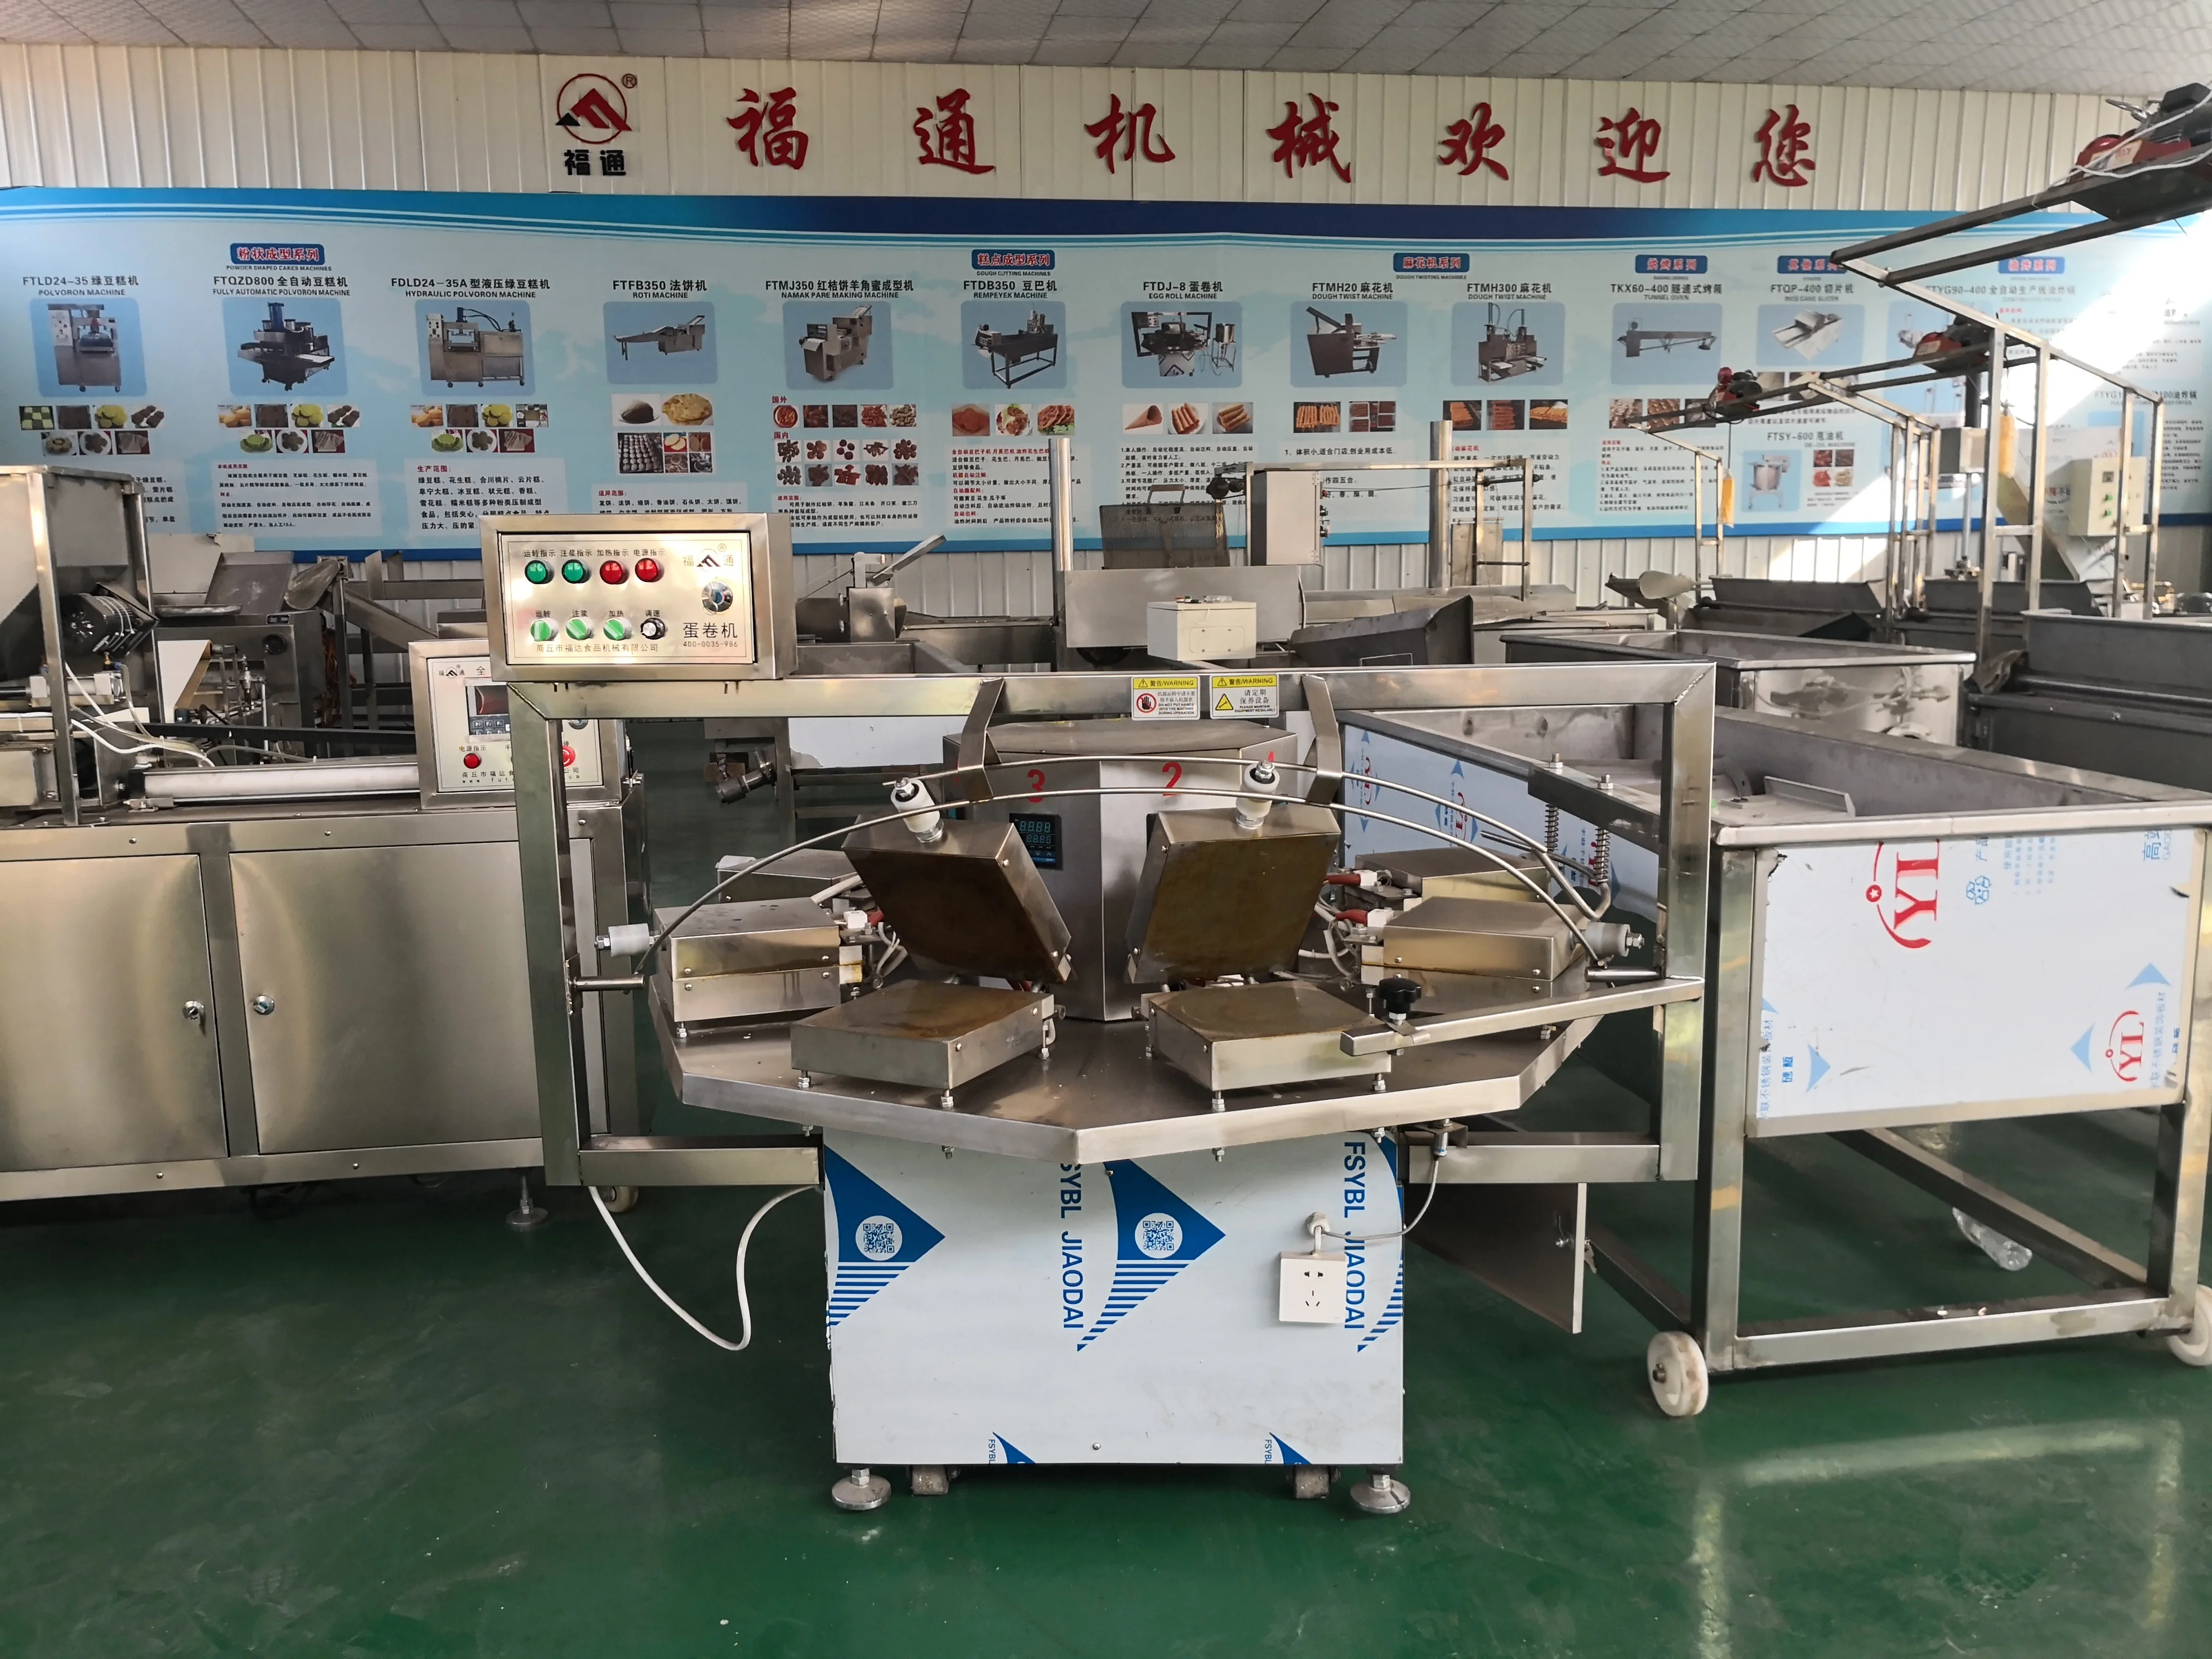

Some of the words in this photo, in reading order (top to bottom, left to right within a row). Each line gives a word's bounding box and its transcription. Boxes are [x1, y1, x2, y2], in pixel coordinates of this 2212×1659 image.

[564, 149, 626, 176] 福通
[237, 247, 319, 261] 粉状成型系列
[978, 253, 1050, 266] 糕点成型系列
[1403, 257, 1461, 269] 麻花机系列
[91, 275, 139, 286] 绿豆糕机
[214, 276, 274, 285] FTQZD800
[277, 276, 348, 287] 全自动豆糕机
[470, 278, 550, 289] 型液压绿豆糕机
[613, 280, 666, 290] FTFB350
[670, 280, 707, 291] 法饼机
[765, 280, 814, 290] FTMJ350
[817, 279, 914, 291] 红桔饼羊角蜜成型机
[964, 281, 1015, 290] FTDB350
[1022, 280, 1057, 291] 豆巴机
[1143, 282, 1186, 290] FTDJ-8
[1190, 281, 1223, 292] 蛋卷机
[1312, 283, 1357, 292] FTMH20
[1360, 282, 1393, 293] 麻花机
[1467, 283, 1517, 292] FTMH300
[1520, 283, 1551, 293] 麻花机
[683, 555, 693, 566] 福
[724, 555, 734, 566] 通
[683, 622, 738, 638] 蛋卷机
[536, 643, 658, 652] 商丘市福达食品机械有限公司
[476, 666, 486, 675] 全
[1162, 761, 1182, 796] 2
[1027, 769, 1045, 803] 3
[1344, 1142, 1366, 1218] FSYBL
[1061, 1231, 1084, 1328] JIAODAI
[1344, 1231, 1365, 1328] JIAODAI
